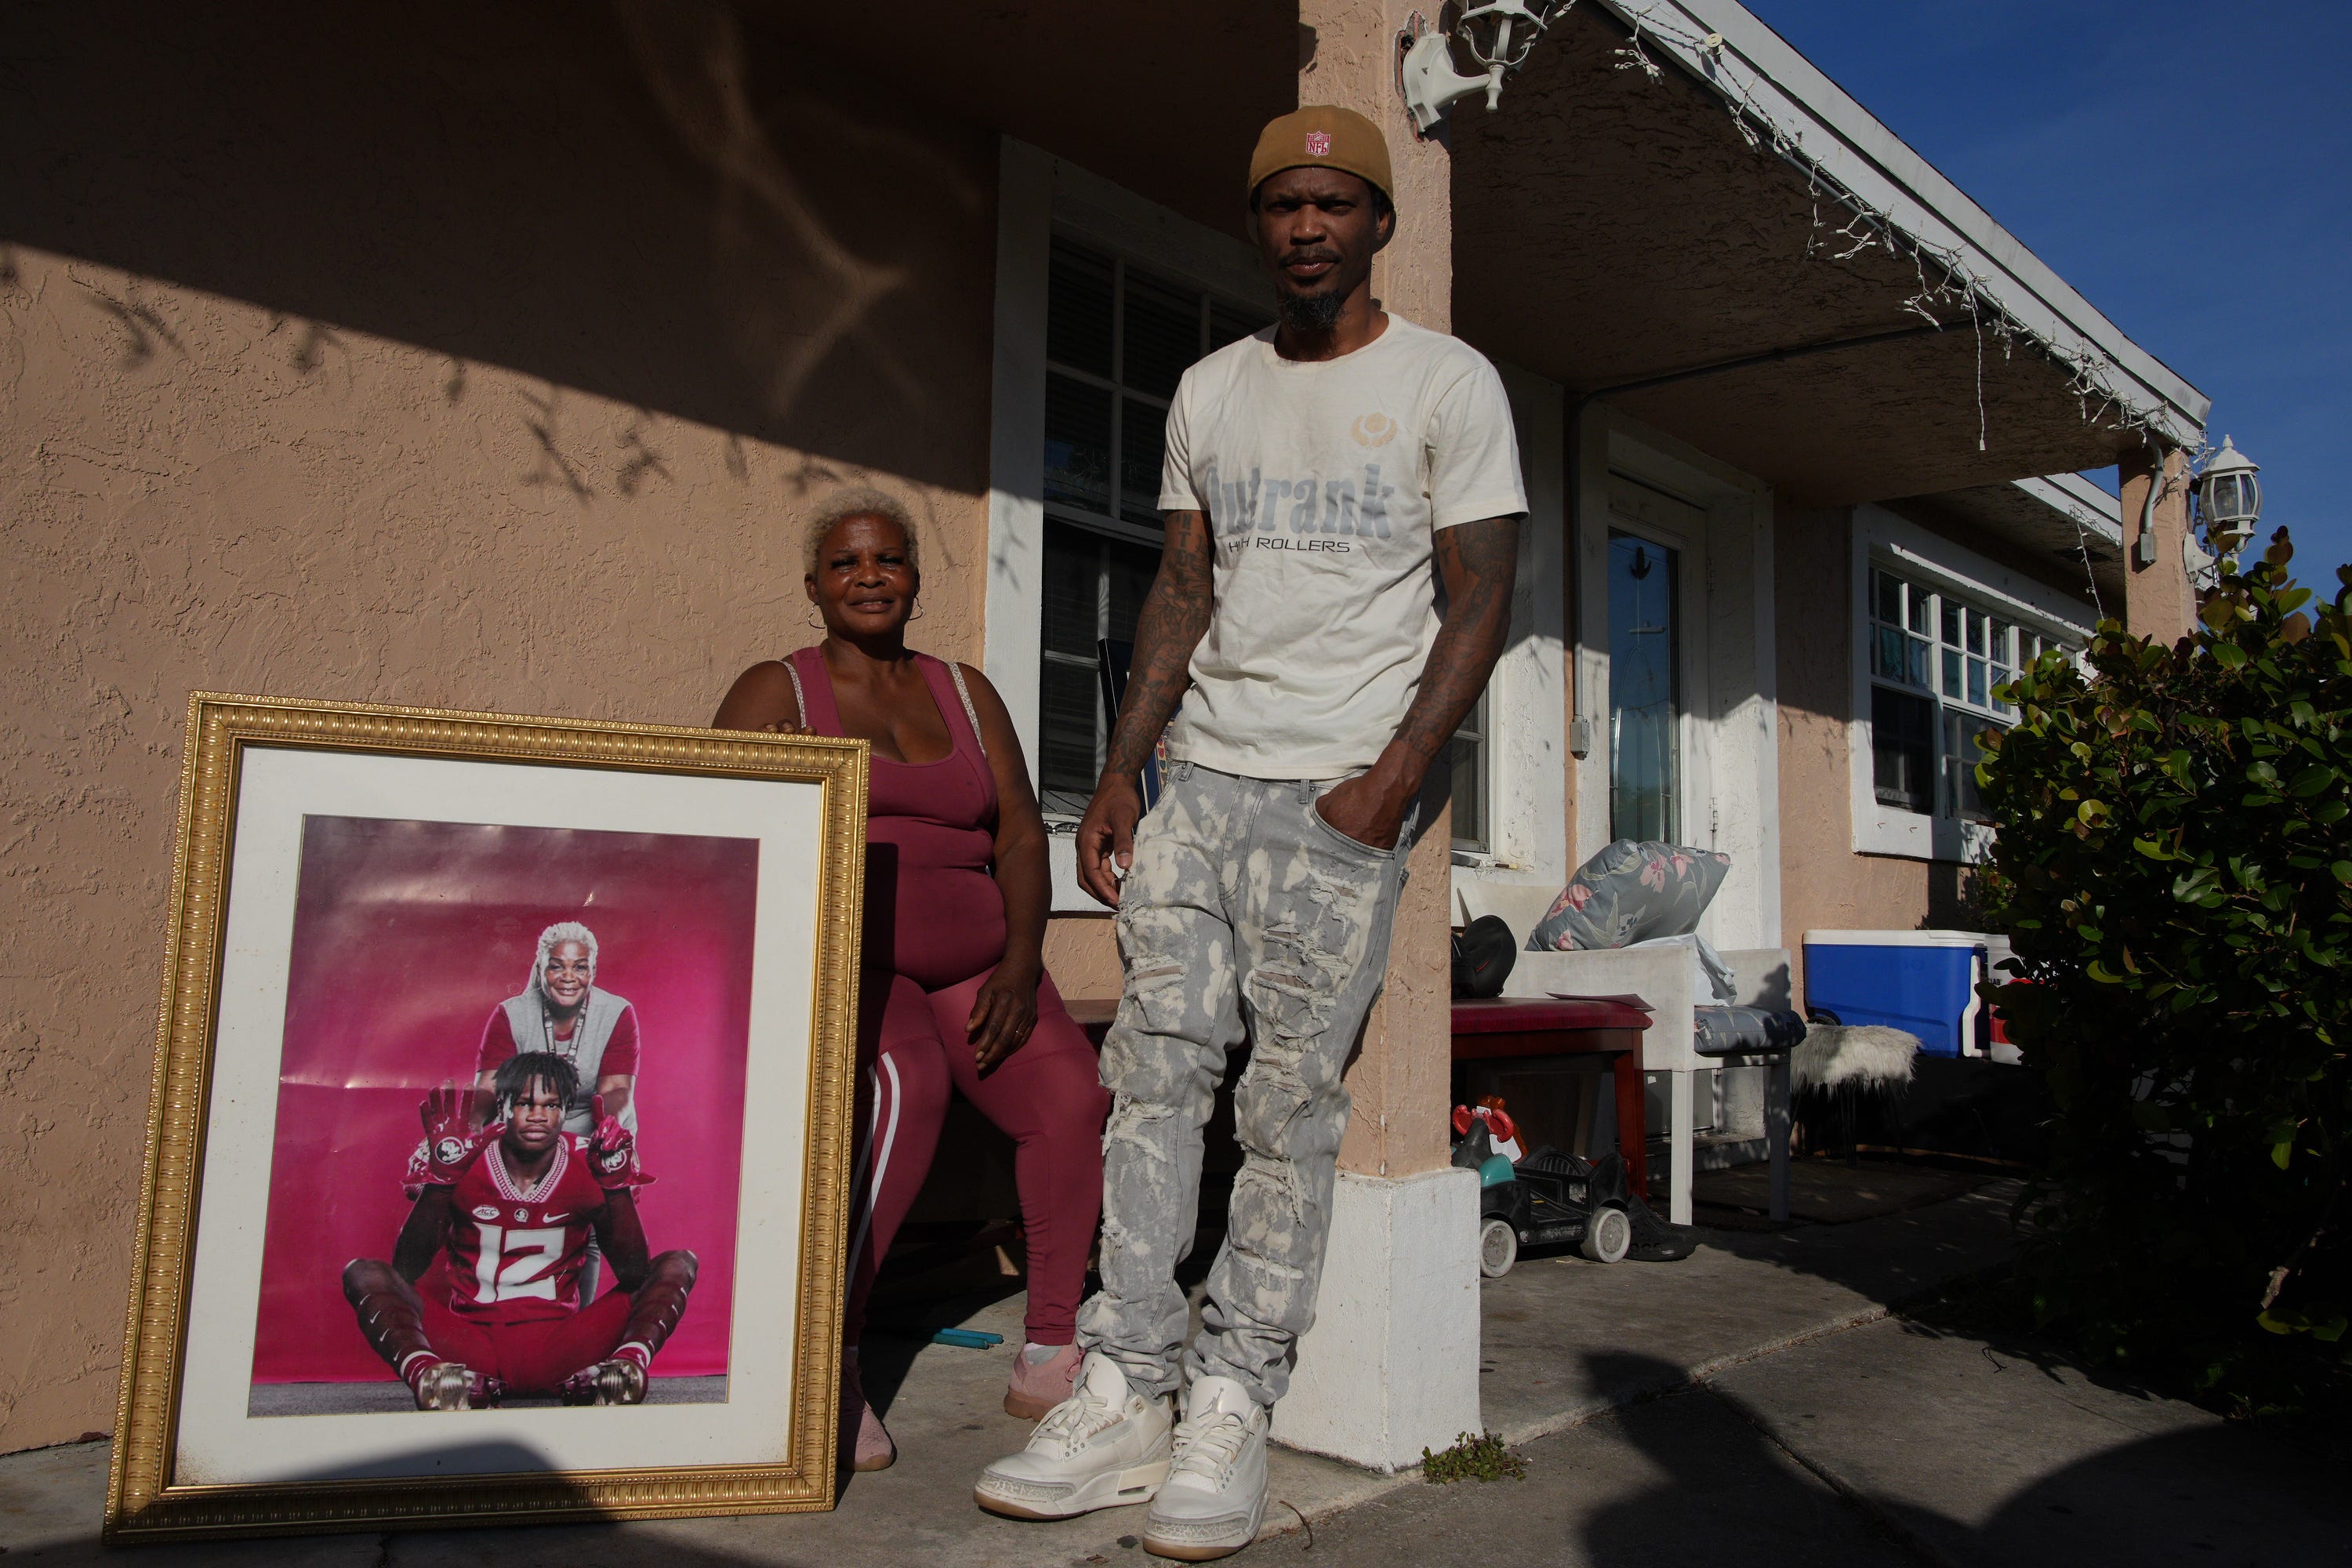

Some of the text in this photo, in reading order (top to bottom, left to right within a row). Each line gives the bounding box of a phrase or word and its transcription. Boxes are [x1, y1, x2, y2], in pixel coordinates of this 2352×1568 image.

[1308, 142, 1327, 154] NFL
[1256, 537, 1350, 553] ROLLERS
[473, 1222, 565, 1303] 12
